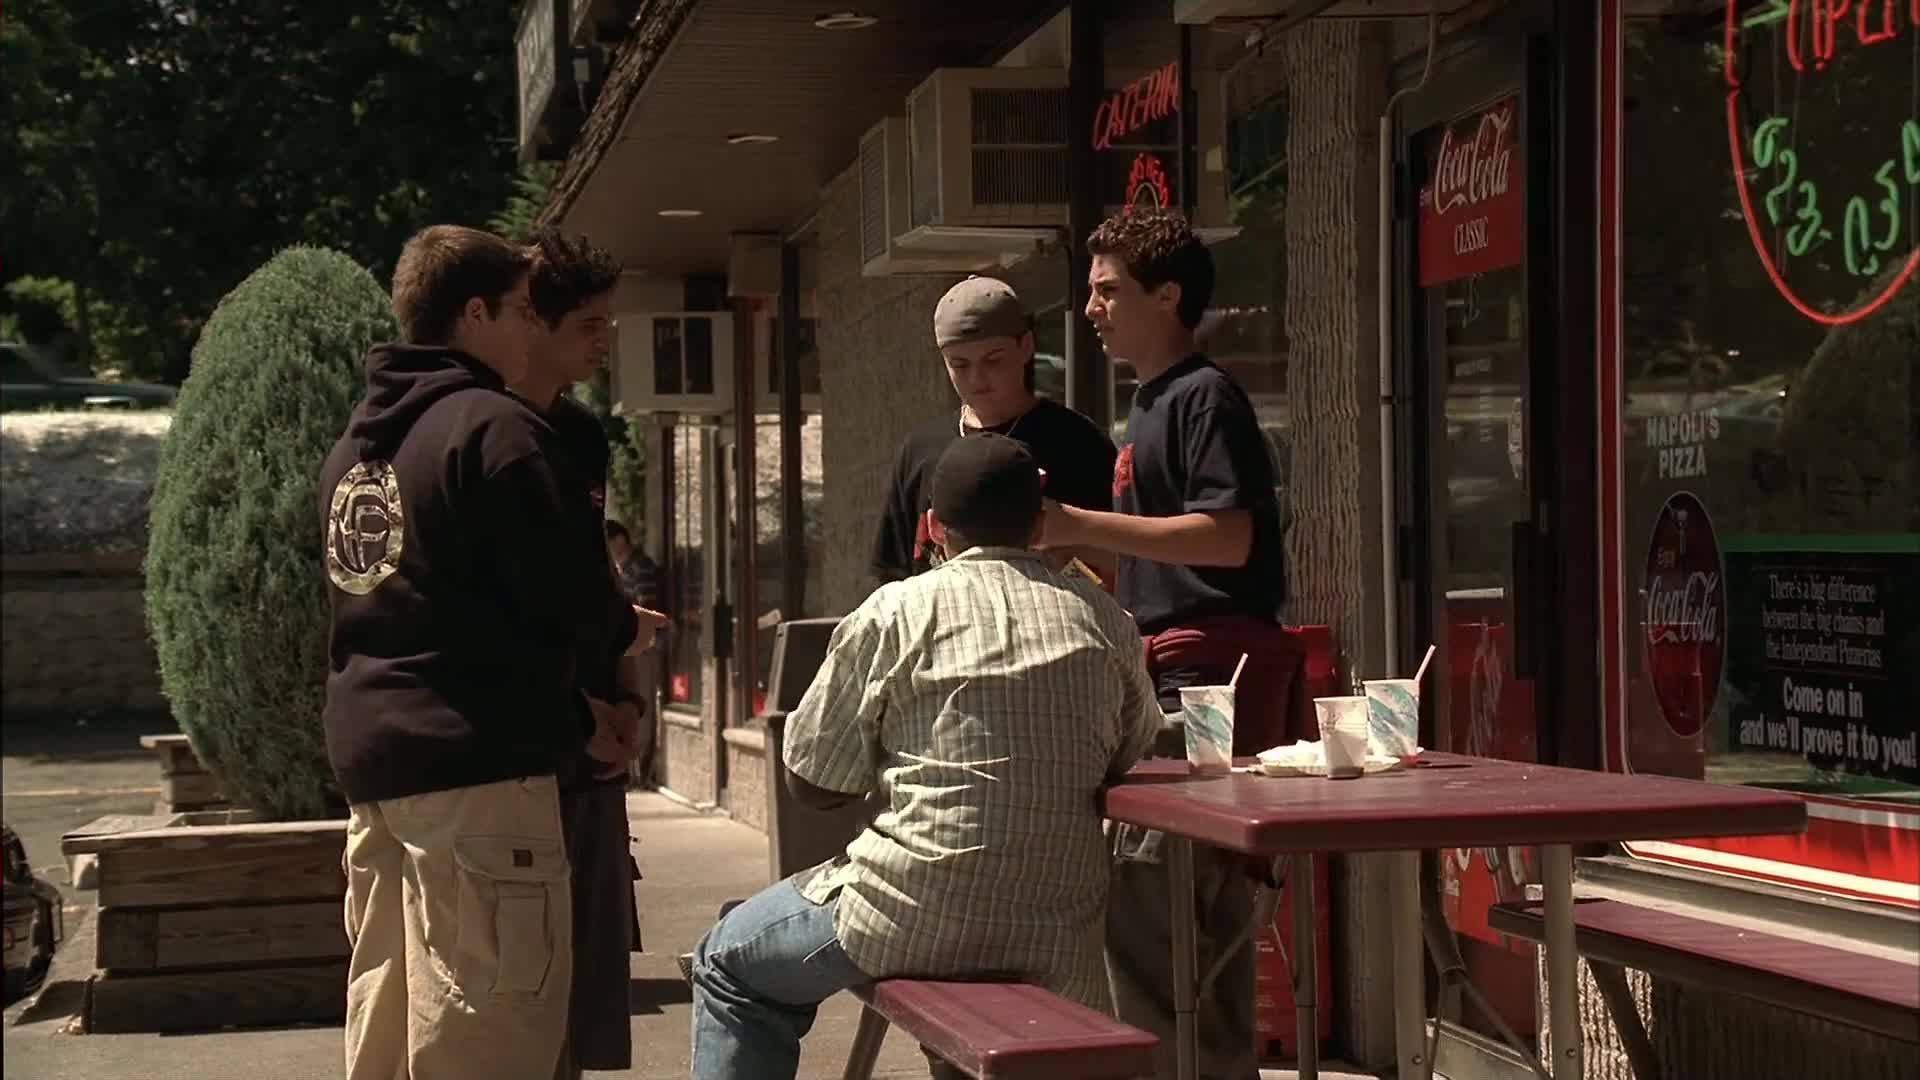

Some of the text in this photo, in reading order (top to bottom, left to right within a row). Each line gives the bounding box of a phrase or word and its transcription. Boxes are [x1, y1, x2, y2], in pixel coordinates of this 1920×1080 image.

[1454, 215, 1489, 255] CLASSIC
[1646, 407, 1721, 448] NAPOLI'S
[1658, 444, 1708, 479] PIZZA
[1768, 573, 1800, 600] There's
[1800, 604, 1816, 630] the
[1817, 606, 1832, 638] big
[1865, 608, 1885, 636] and
[1783, 676, 1864, 718] Come on in
[1739, 711, 1918, 772] and we'll prove it to you!
